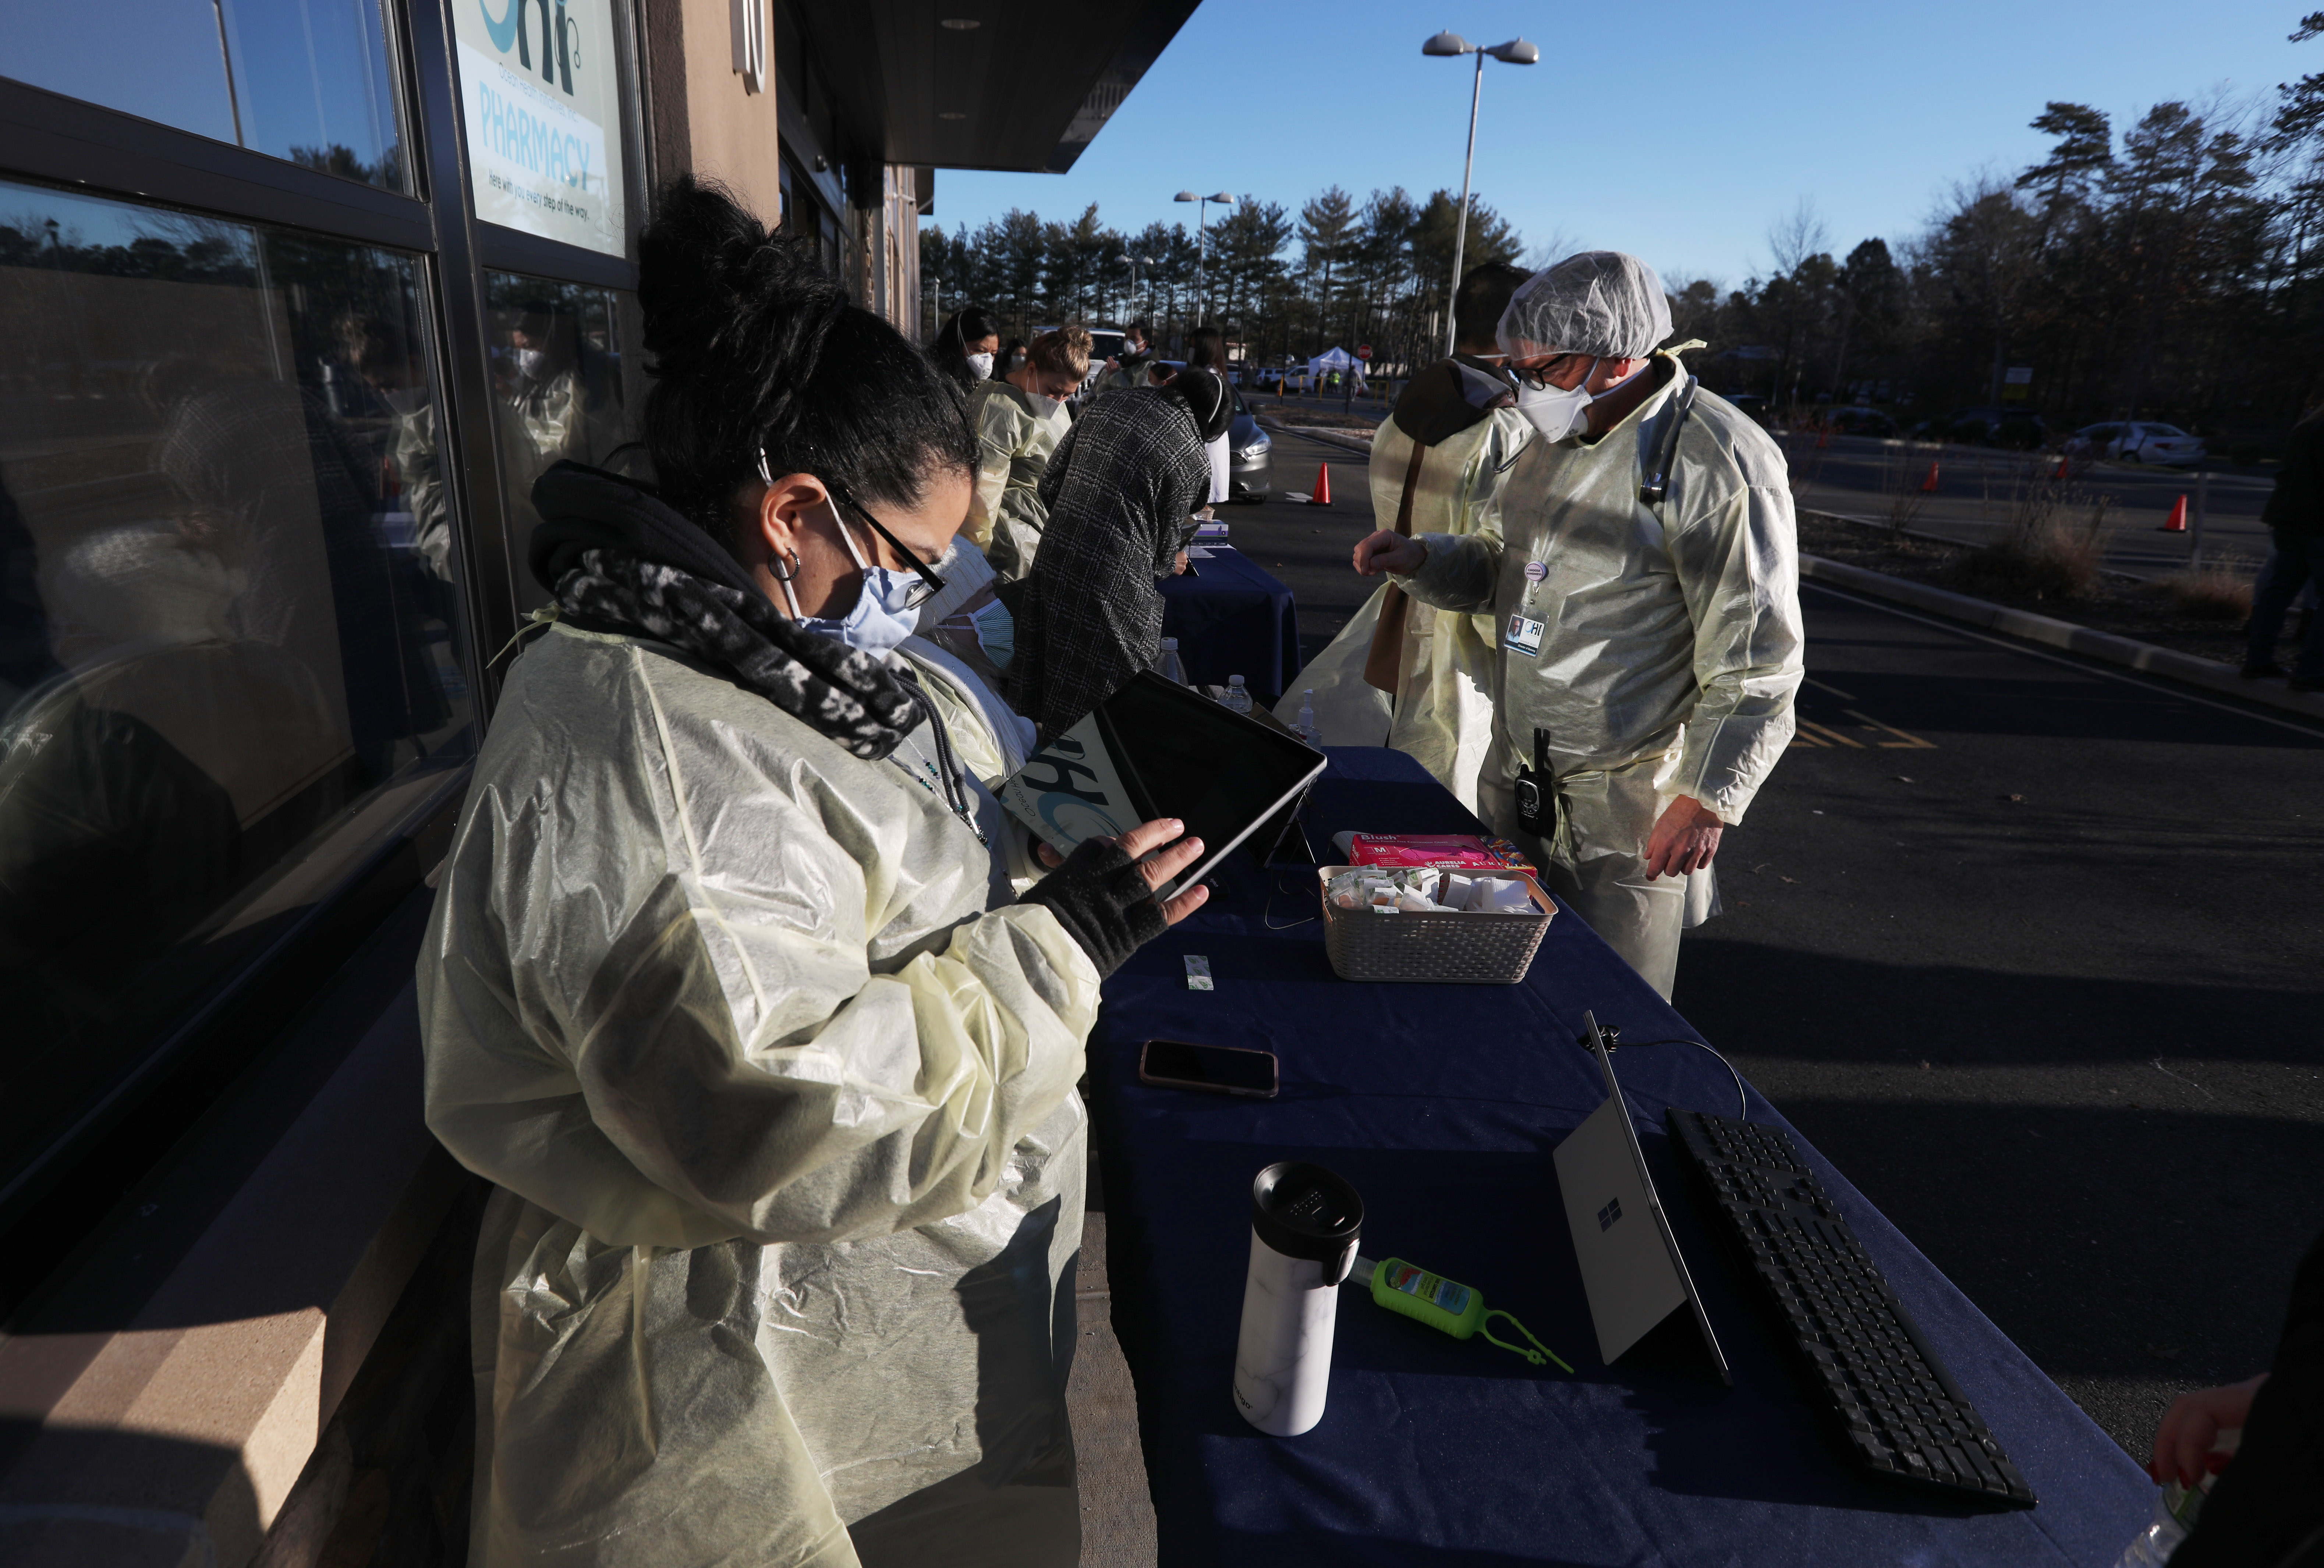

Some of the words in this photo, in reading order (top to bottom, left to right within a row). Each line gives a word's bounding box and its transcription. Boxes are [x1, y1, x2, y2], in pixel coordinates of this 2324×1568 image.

[499, 62, 518, 86] Ocean
[519, 76, 538, 100] Health
[479, 80, 589, 191] PHARMACY
[489, 168, 501, 189] Here
[502, 177, 513, 194] with
[515, 185, 524, 199] you
[526, 189, 542, 208] every
[543, 192, 556, 213] step
[557, 198, 564, 212] of
[564, 199, 574, 215] the
[575, 206, 589, 221] way.
[1525, 621, 1542, 636] OHI
